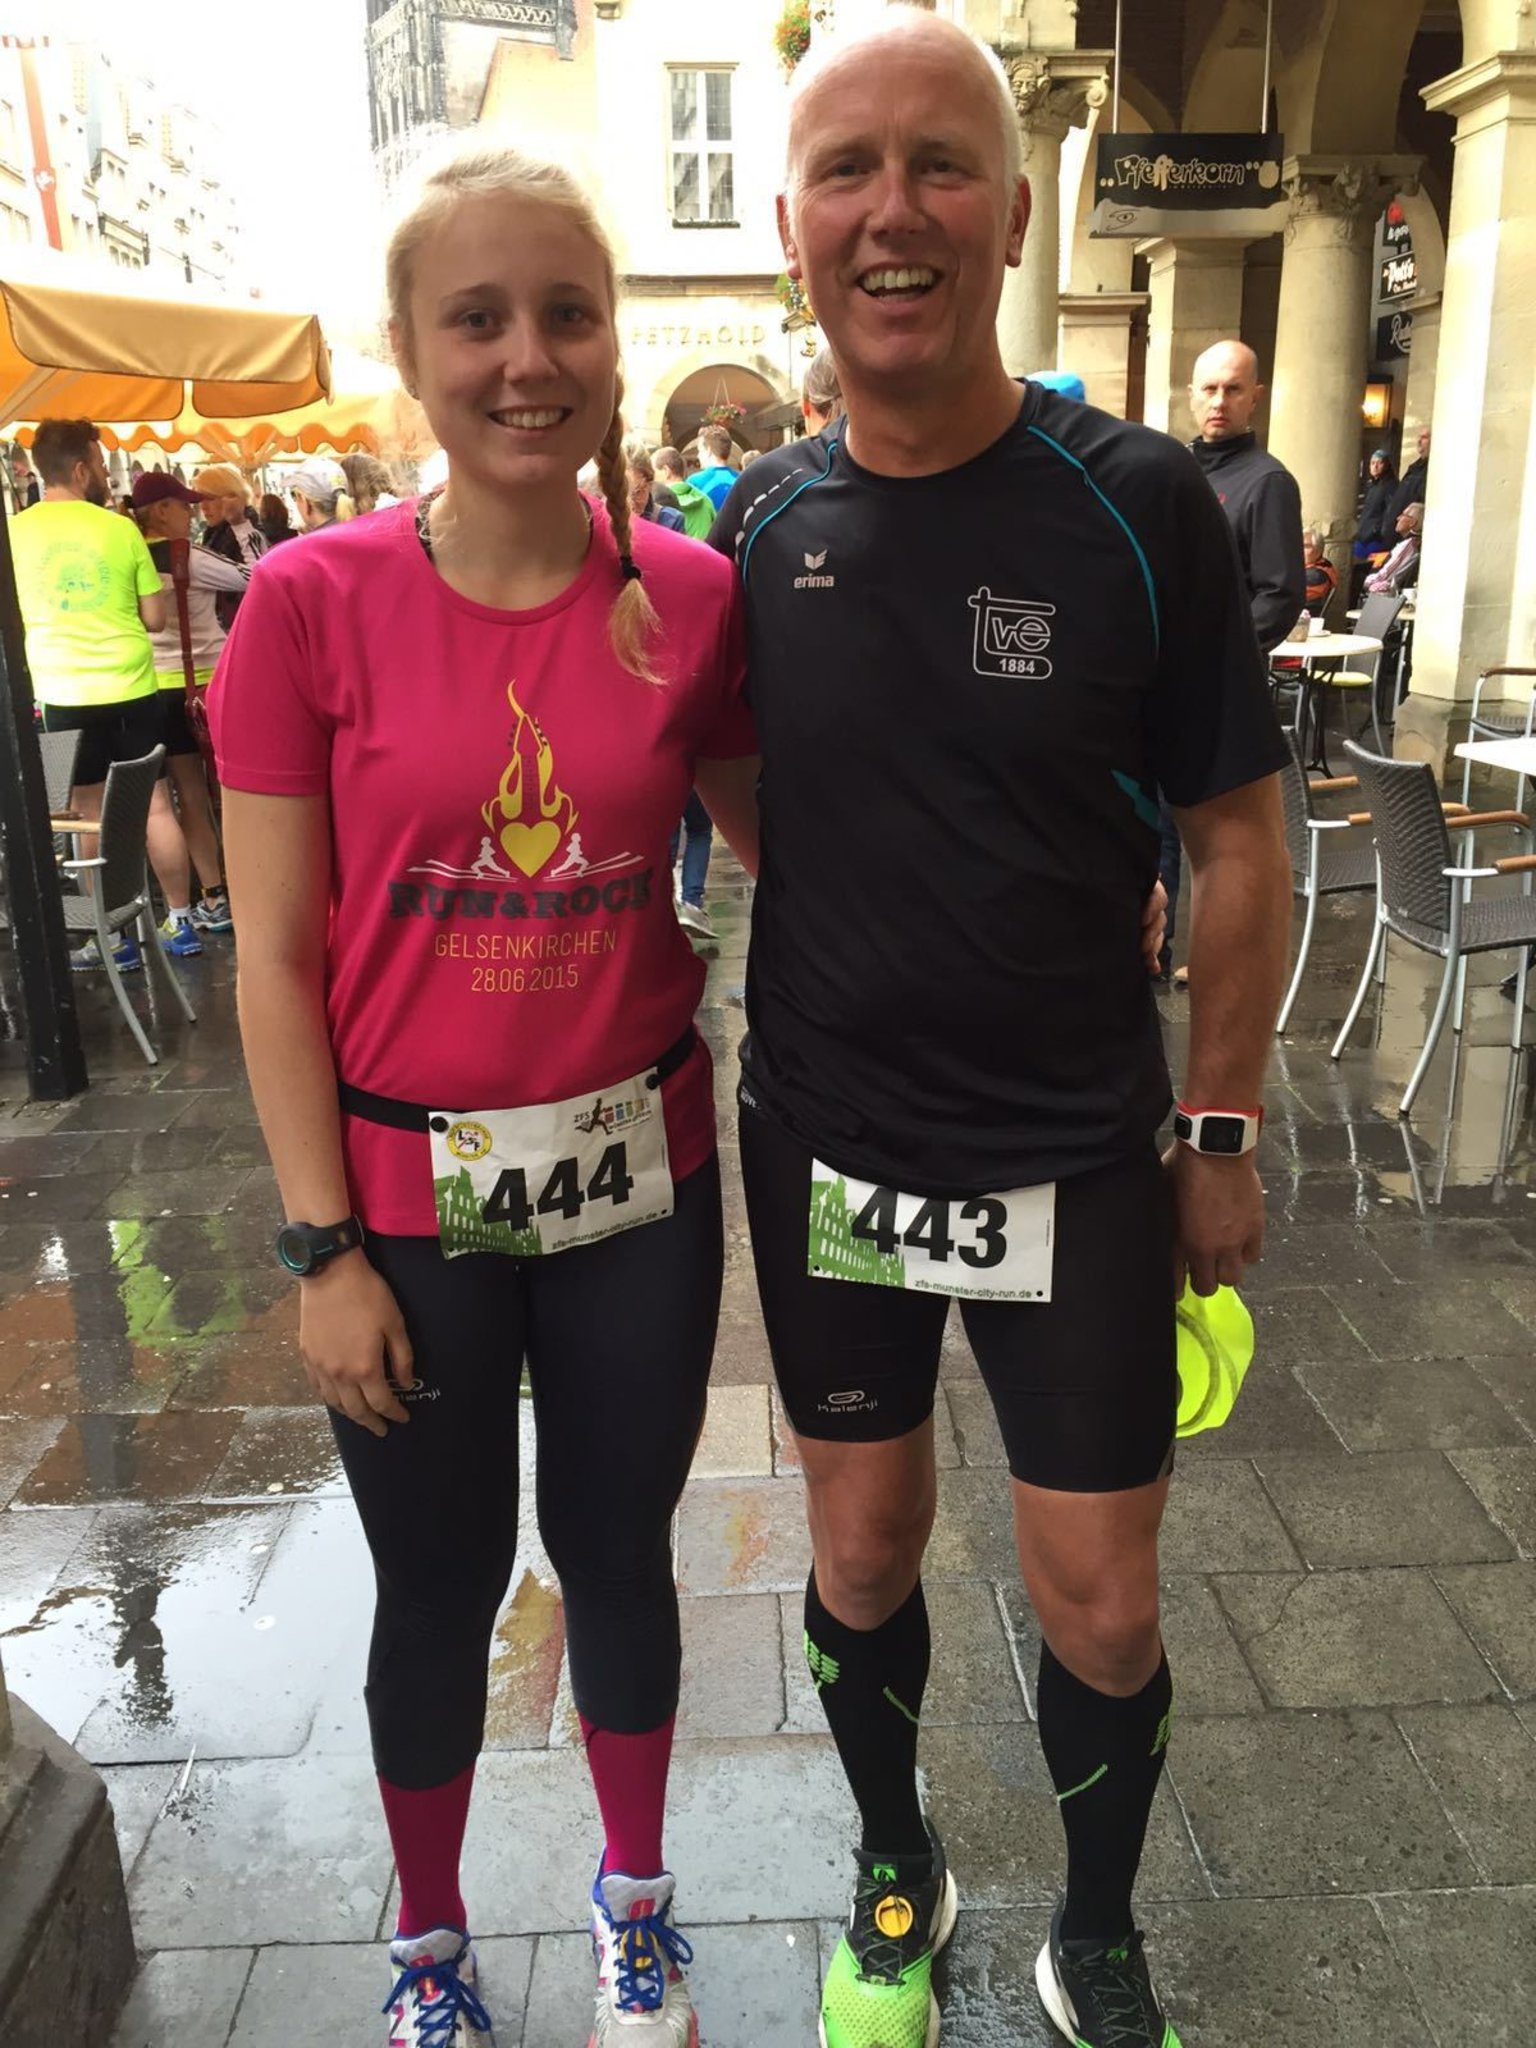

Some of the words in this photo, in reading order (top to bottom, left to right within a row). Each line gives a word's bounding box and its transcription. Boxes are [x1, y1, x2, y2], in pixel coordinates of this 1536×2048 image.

[1114, 153, 1245, 192] Pfefferkorn
[793, 573, 835, 589] erima
[999, 658, 1036, 675] 1884
[434, 930, 617, 960] GELSENKIRCHEN
[470, 963, 580, 993] 28.06.2015
[482, 1141, 635, 1232] 444
[851, 1186, 1009, 1270] 443
